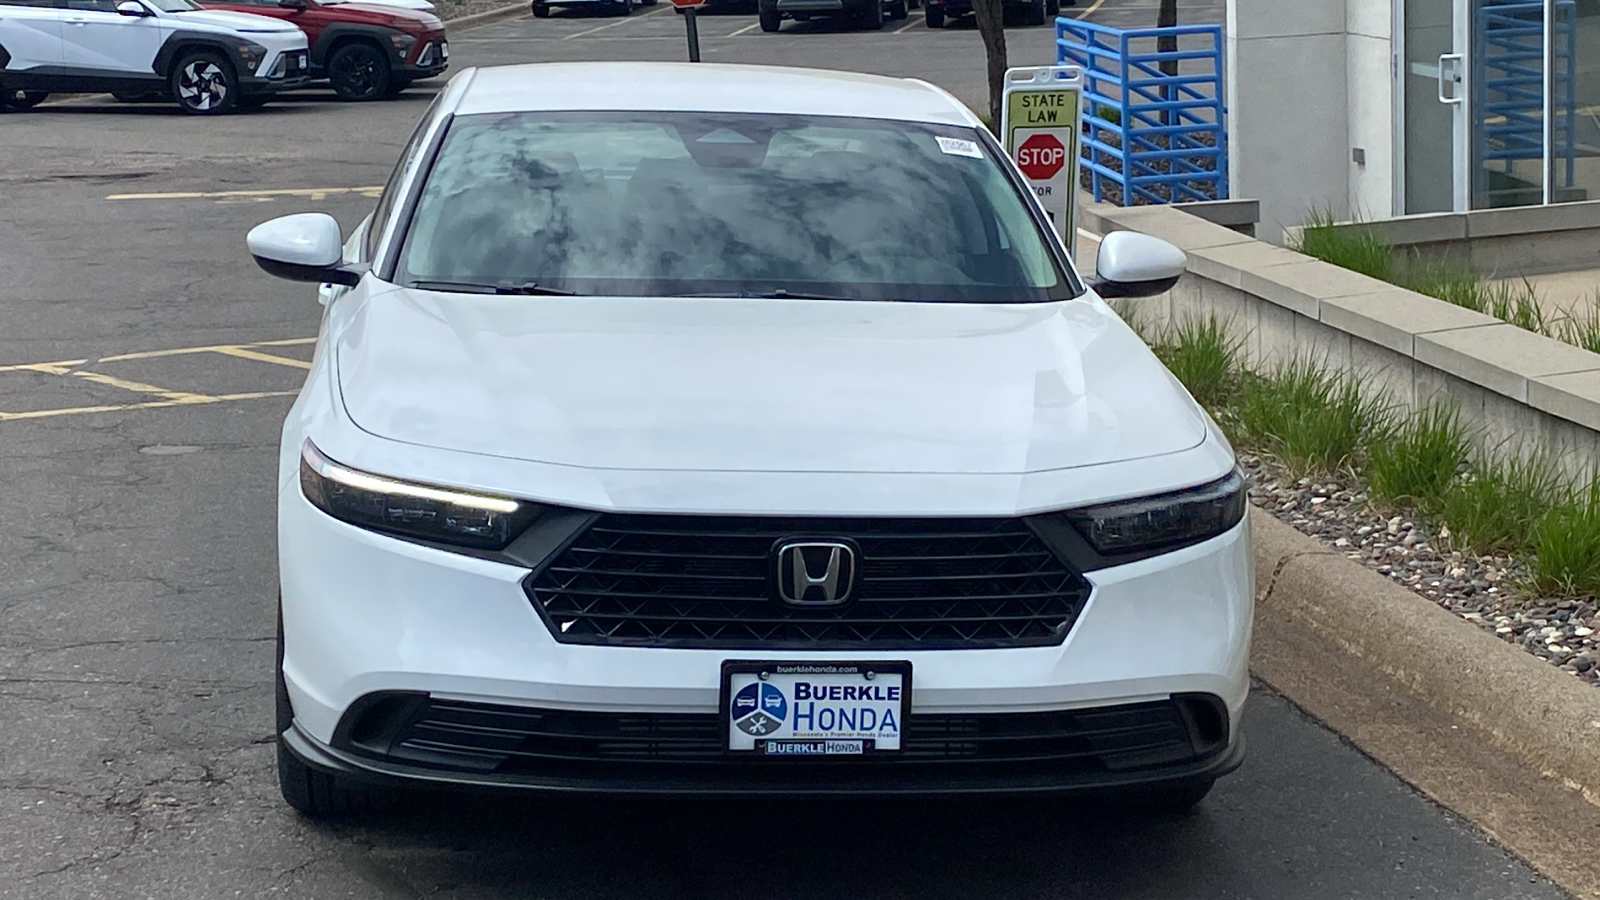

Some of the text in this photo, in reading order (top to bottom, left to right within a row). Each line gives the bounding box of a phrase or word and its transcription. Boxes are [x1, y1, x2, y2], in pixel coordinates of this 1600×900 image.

[1022, 94, 1065, 108] STATE
[1028, 110, 1058, 123] LAW
[1019, 148, 1065, 166] STOP
[776, 665, 858, 674] buerklehonda.com
[794, 682, 901, 701] BUERKLE
[793, 702, 898, 732] HONDA
[767, 741, 861, 753] BUERKLE HONDA
